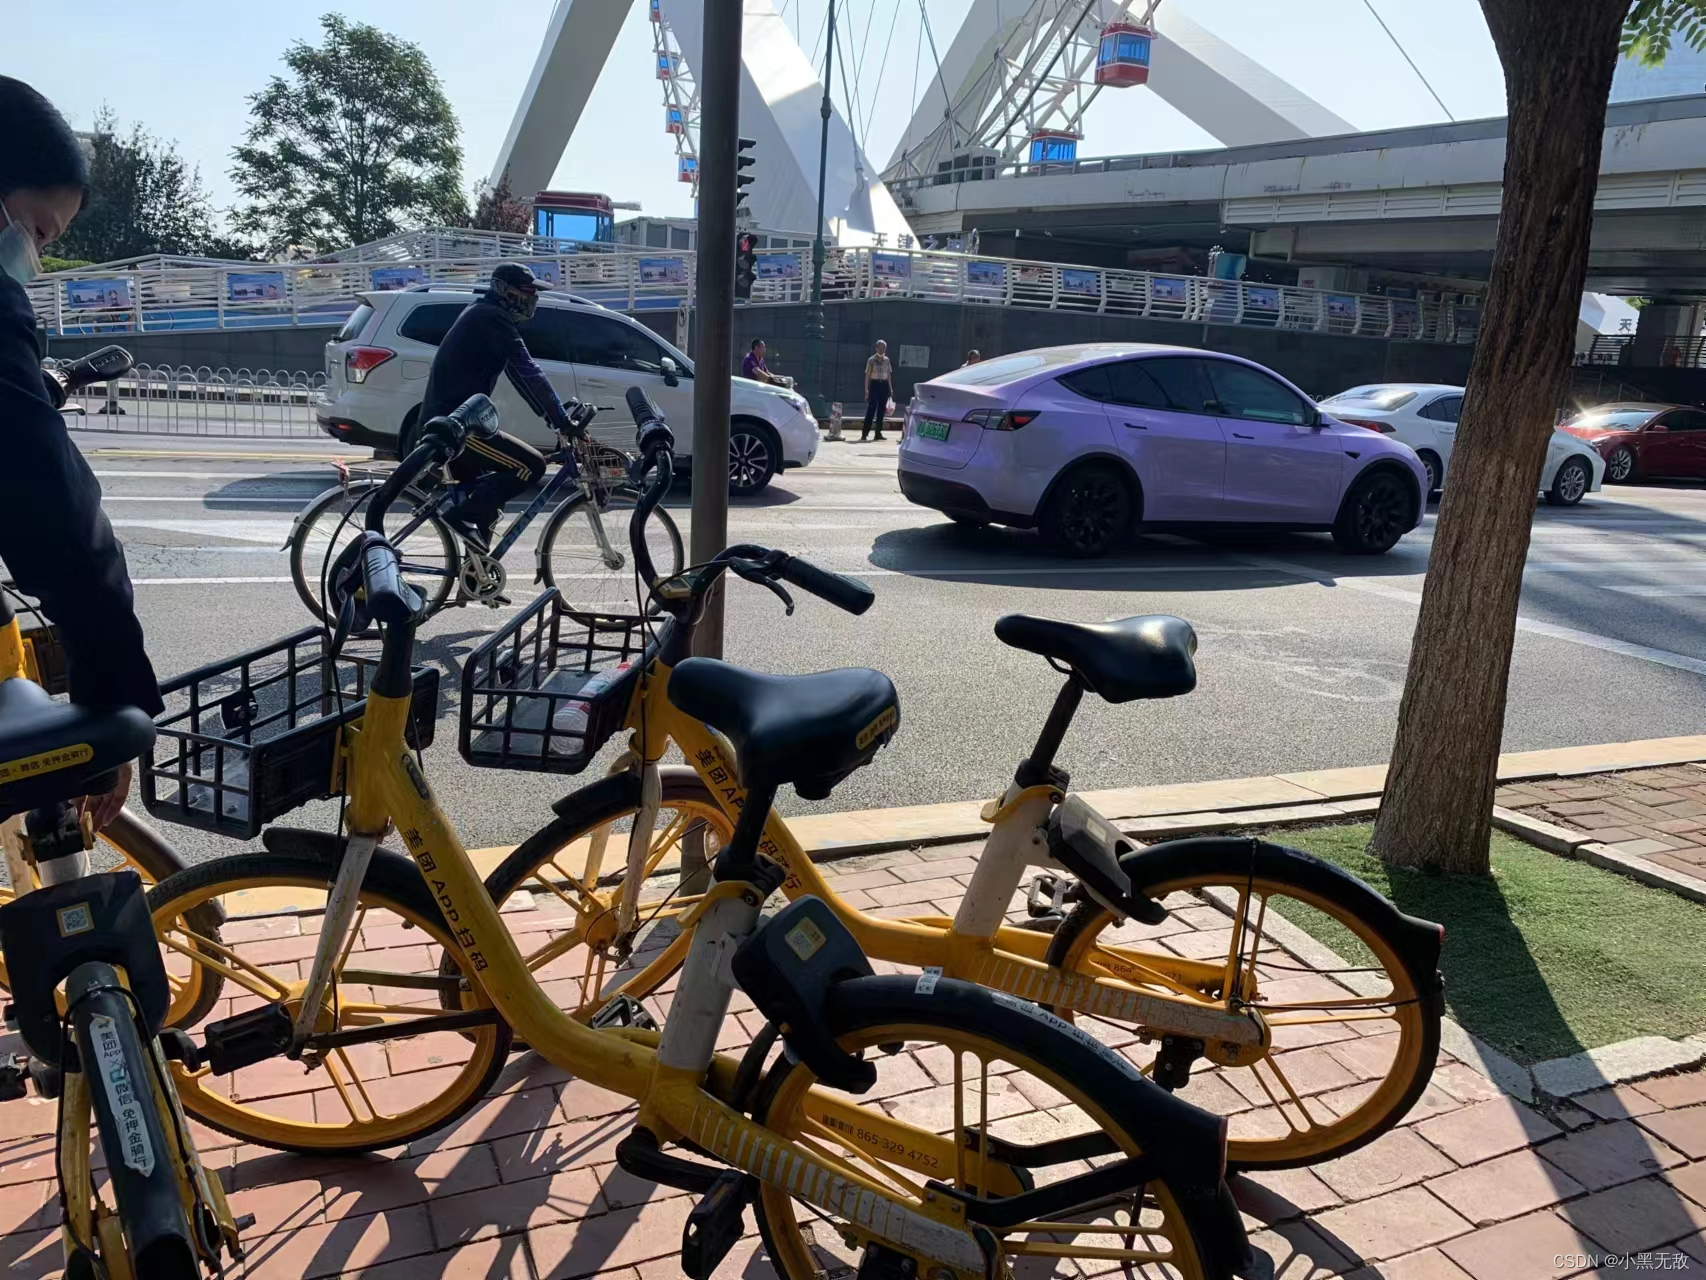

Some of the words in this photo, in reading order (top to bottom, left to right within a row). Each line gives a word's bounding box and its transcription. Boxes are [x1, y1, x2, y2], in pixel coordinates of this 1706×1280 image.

[403, 827, 489, 972] 美团App扫码
[122, 1108, 148, 1168] 免押金骑行
[856, 1128, 879, 1145] 865
[881, 1138, 905, 1155] 329
[907, 1149, 939, 1169] 4752
